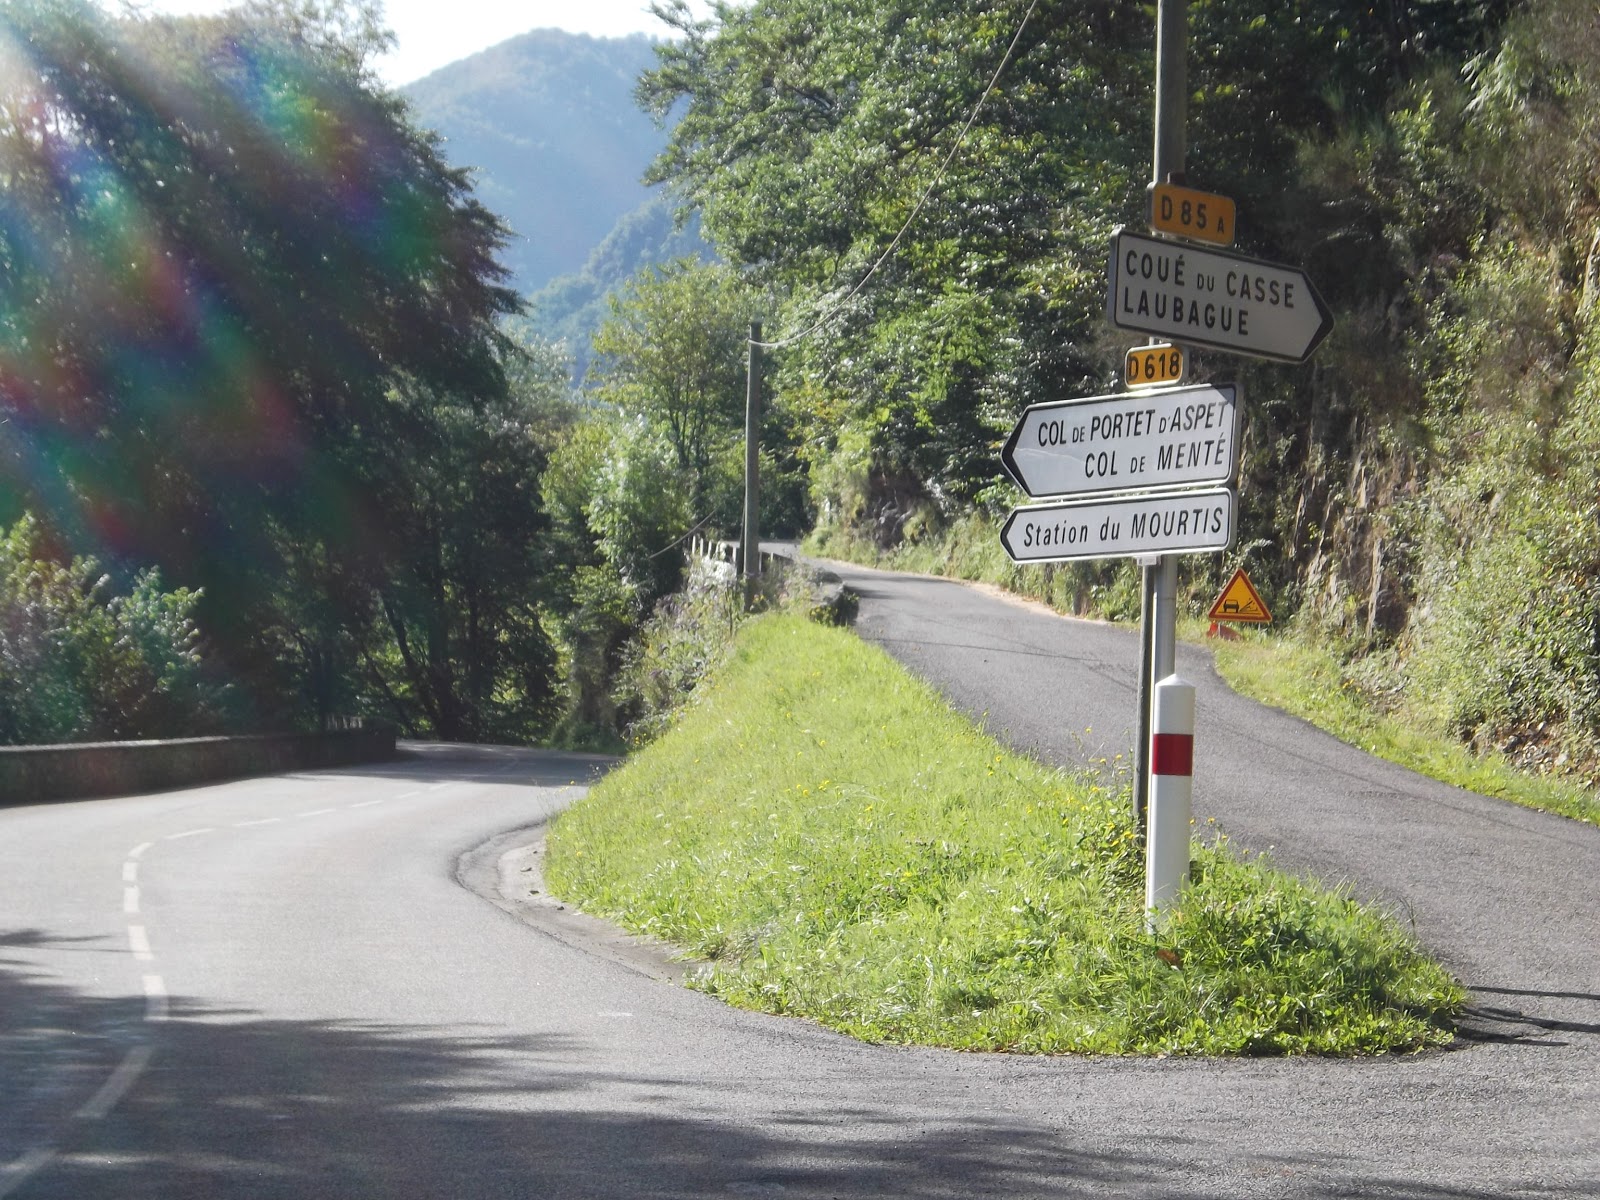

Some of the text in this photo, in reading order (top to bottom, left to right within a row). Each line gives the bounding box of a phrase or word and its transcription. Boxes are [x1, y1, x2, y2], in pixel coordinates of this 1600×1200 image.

[1126, 250, 1294, 309] COUÉ DU CASSE
[1124, 286, 1249, 336] LAUBAGUE
[1038, 401, 1229, 447] COL DE PORTET D'ASPET
[1085, 432, 1226, 478] COL DE MENTÉ
[1024, 507, 1223, 548] Station du MOURTIS
